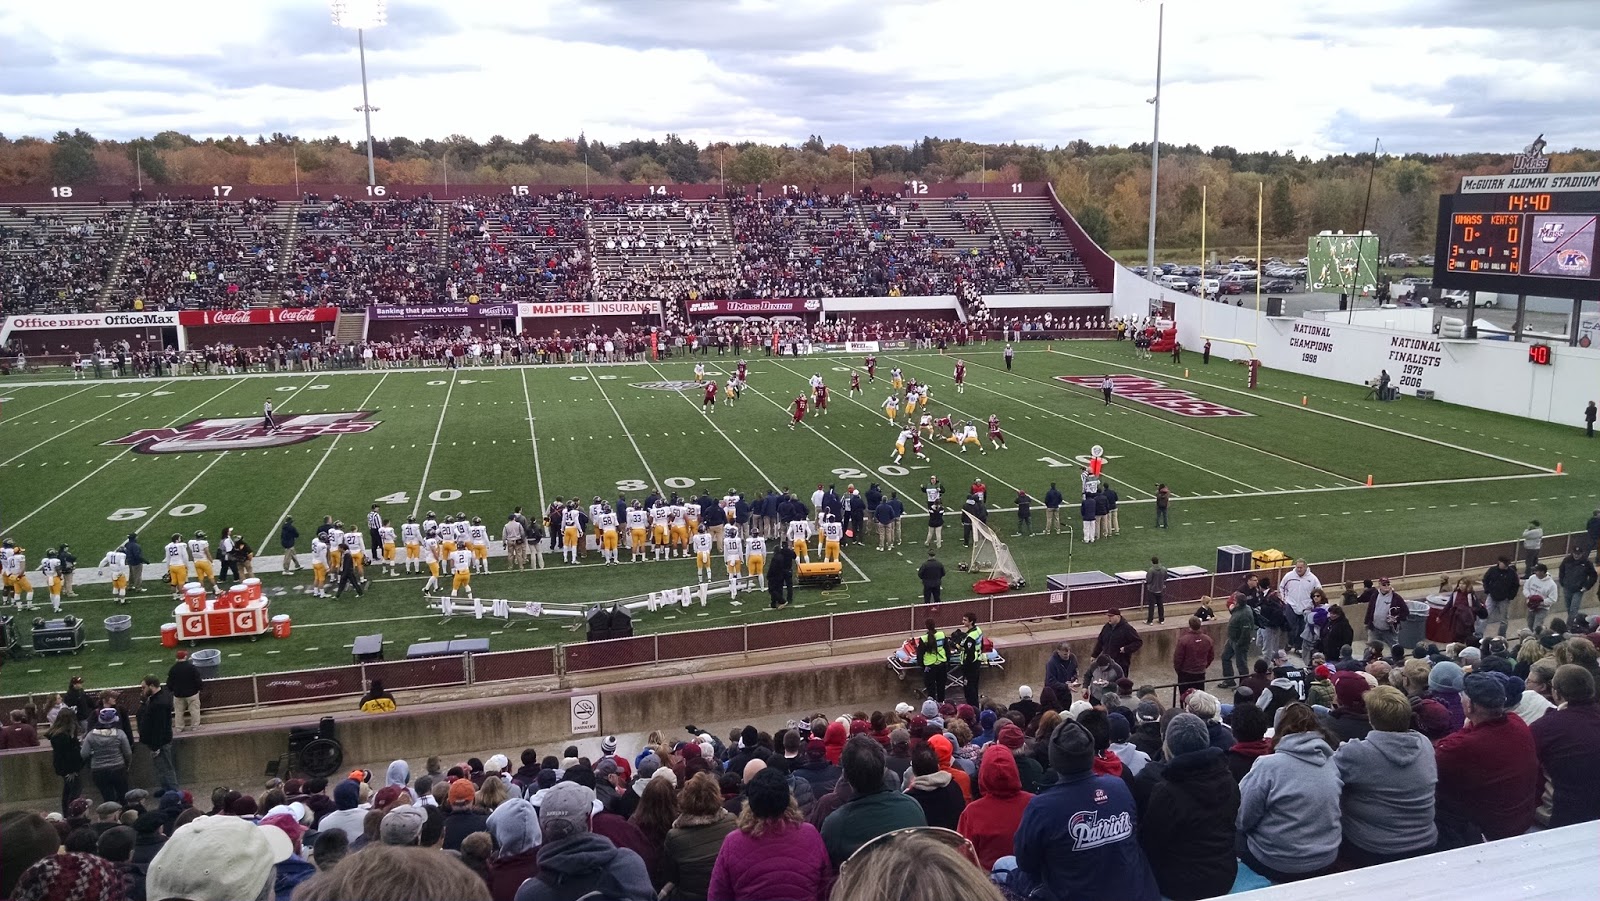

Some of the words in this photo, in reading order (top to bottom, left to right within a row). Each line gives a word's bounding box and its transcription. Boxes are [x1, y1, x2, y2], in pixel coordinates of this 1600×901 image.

[1012, 183, 1023, 193] 11
[1463, 178, 1505, 190] McGUIRK
[1507, 177, 1549, 189] ALUMNI
[1551, 175, 1600, 188] STADIUM
[51, 186, 73, 198] 18
[212, 185, 233, 197] 17
[366, 185, 386, 197] 16
[511, 185, 529, 196] 15
[649, 185, 667, 196] 14
[911, 183, 929, 194] 12
[1508, 195, 1551, 211] 14:40
[1455, 215, 1483, 225] UMASS
[1464, 227, 1474, 242] 0
[1507, 227, 1518, 243] 0
[1452, 245, 1458, 256] 3
[1511, 247, 1518, 259] 3
[1449, 258, 1456, 270] 2
[1471, 259, 1479, 271] 10
[1510, 262, 1518, 272] 14
[421, 307, 437, 316] puts
[532, 304, 590, 314] MAPFRE
[597, 302, 658, 313] INSURANCE
[13, 318, 57, 328] Office
[59, 319, 101, 327] DEPOT
[105, 314, 174, 325] OfficeMax
[1294, 323, 1331, 338] NATIONAL
[1290, 337, 1334, 353] CHAMPIONS
[1391, 336, 1441, 352] NATIONAL
[1302, 352, 1318, 364] 1998
[1389, 350, 1442, 368] FINALISTS
[1530, 347, 1547, 364] 40
[1403, 364, 1424, 376] 1978
[1400, 375, 1423, 388] 2006
[565, 512, 573, 521] 34
[633, 514, 642, 523] 33
[656, 510, 666, 519] 52
[602, 516, 613, 526] 58
[405, 527, 413, 536] 31
[442, 526, 450, 535] 20
[472, 529, 481, 538] 28
[795, 524, 803, 533] 14
[827, 525, 837, 535] 98
[347, 535, 356, 545] 27
[700, 537, 706, 546] 2
[729, 541, 737, 550] 10
[751, 541, 761, 550] 22
[169, 546, 179, 556] 82
[192, 543, 200, 553] 13
[111, 555, 116, 564] 11
[459, 554, 464, 563] 2
[185, 615, 203, 633] G
[236, 611, 253, 629] G
[1072, 811, 1132, 850] Patriots
